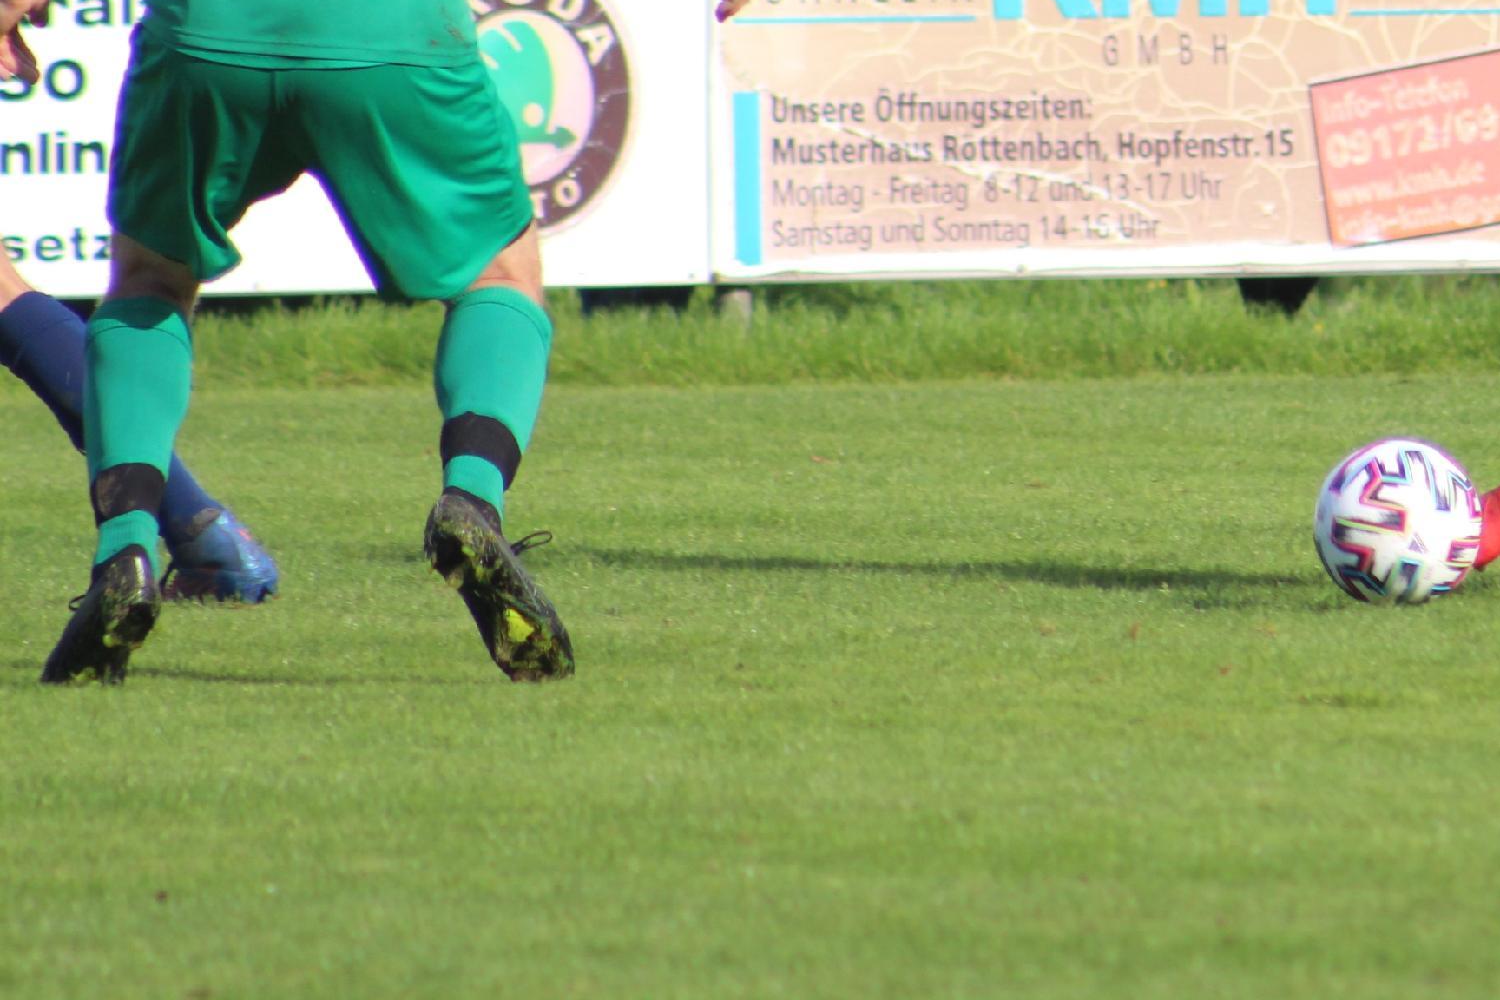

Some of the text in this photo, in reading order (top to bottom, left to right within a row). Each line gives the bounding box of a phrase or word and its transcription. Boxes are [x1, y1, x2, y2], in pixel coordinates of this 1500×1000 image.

[1102, 33, 1230, 67] GMBH
[771, 87, 1093, 129] Unsere Öffnungszeiten:
[0, 131, 107, 174] nlin
[771, 136, 934, 165] Musterhaus
[942, 130, 1109, 164] Röttenbach,
[771, 178, 866, 214] Montag
[889, 174, 970, 212] Freitag
[1049, 172, 1094, 201] und
[1180, 169, 1223, 200] Uhr
[771, 218, 873, 251] Samstag
[881, 214, 926, 244] und
[932, 214, 1031, 248] Sonntag
